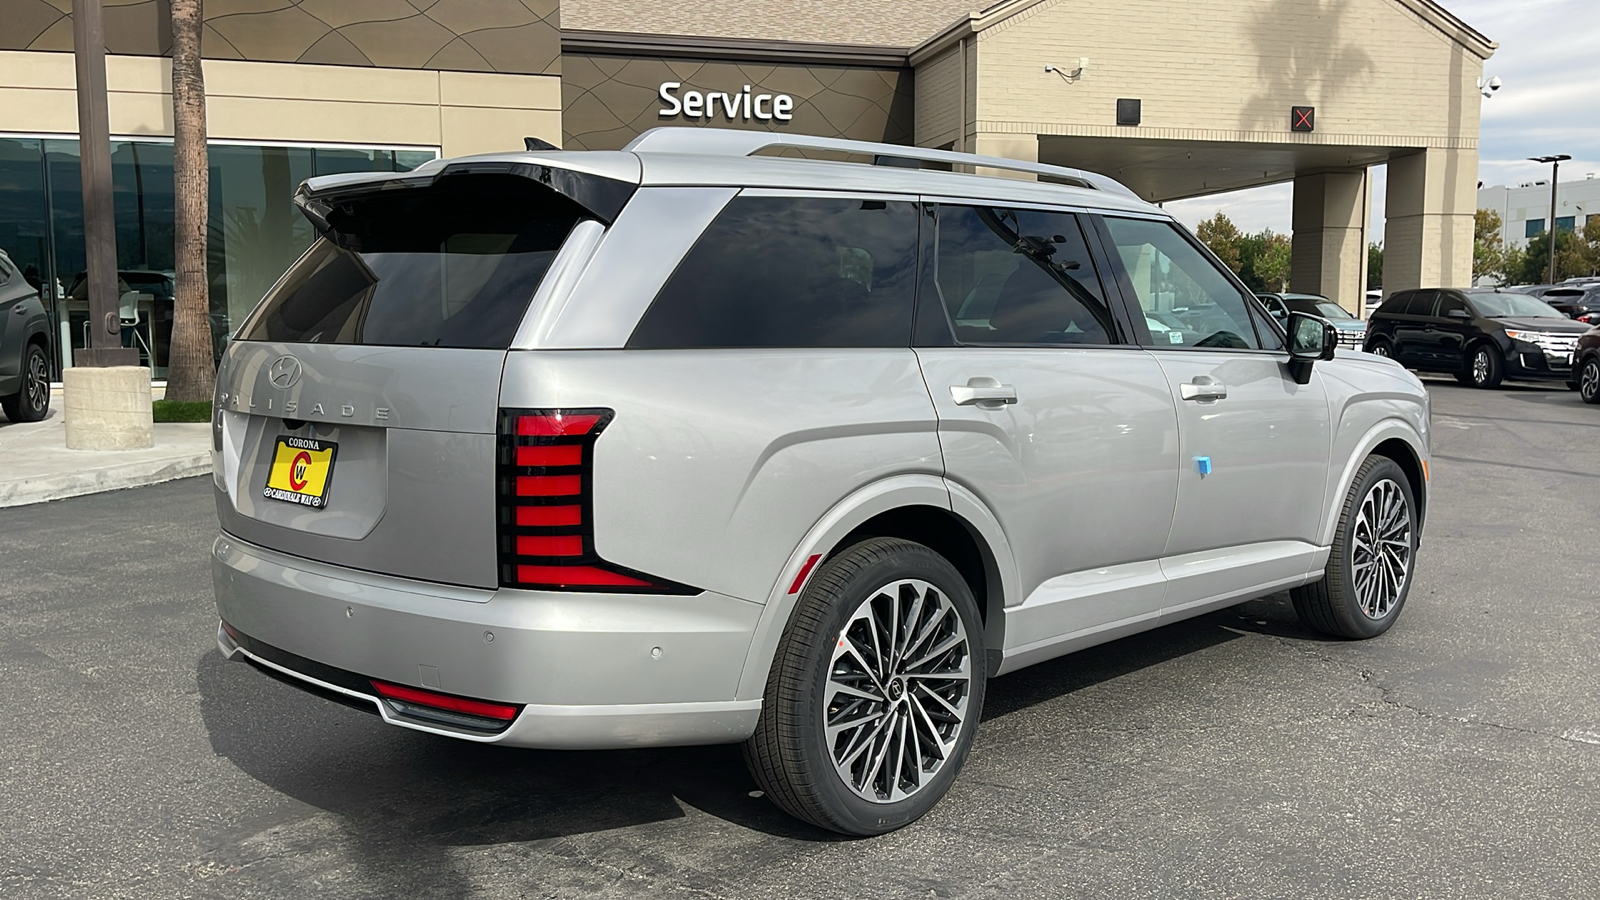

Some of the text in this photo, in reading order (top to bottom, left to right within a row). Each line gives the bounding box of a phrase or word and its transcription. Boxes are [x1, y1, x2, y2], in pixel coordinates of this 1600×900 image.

[659, 81, 793, 120] Service
[219, 393, 391, 420] PALISADE
[288, 437, 320, 450] CORONA
[295, 465, 307, 480] W
[271, 489, 314, 505] CARDINALE WAY
